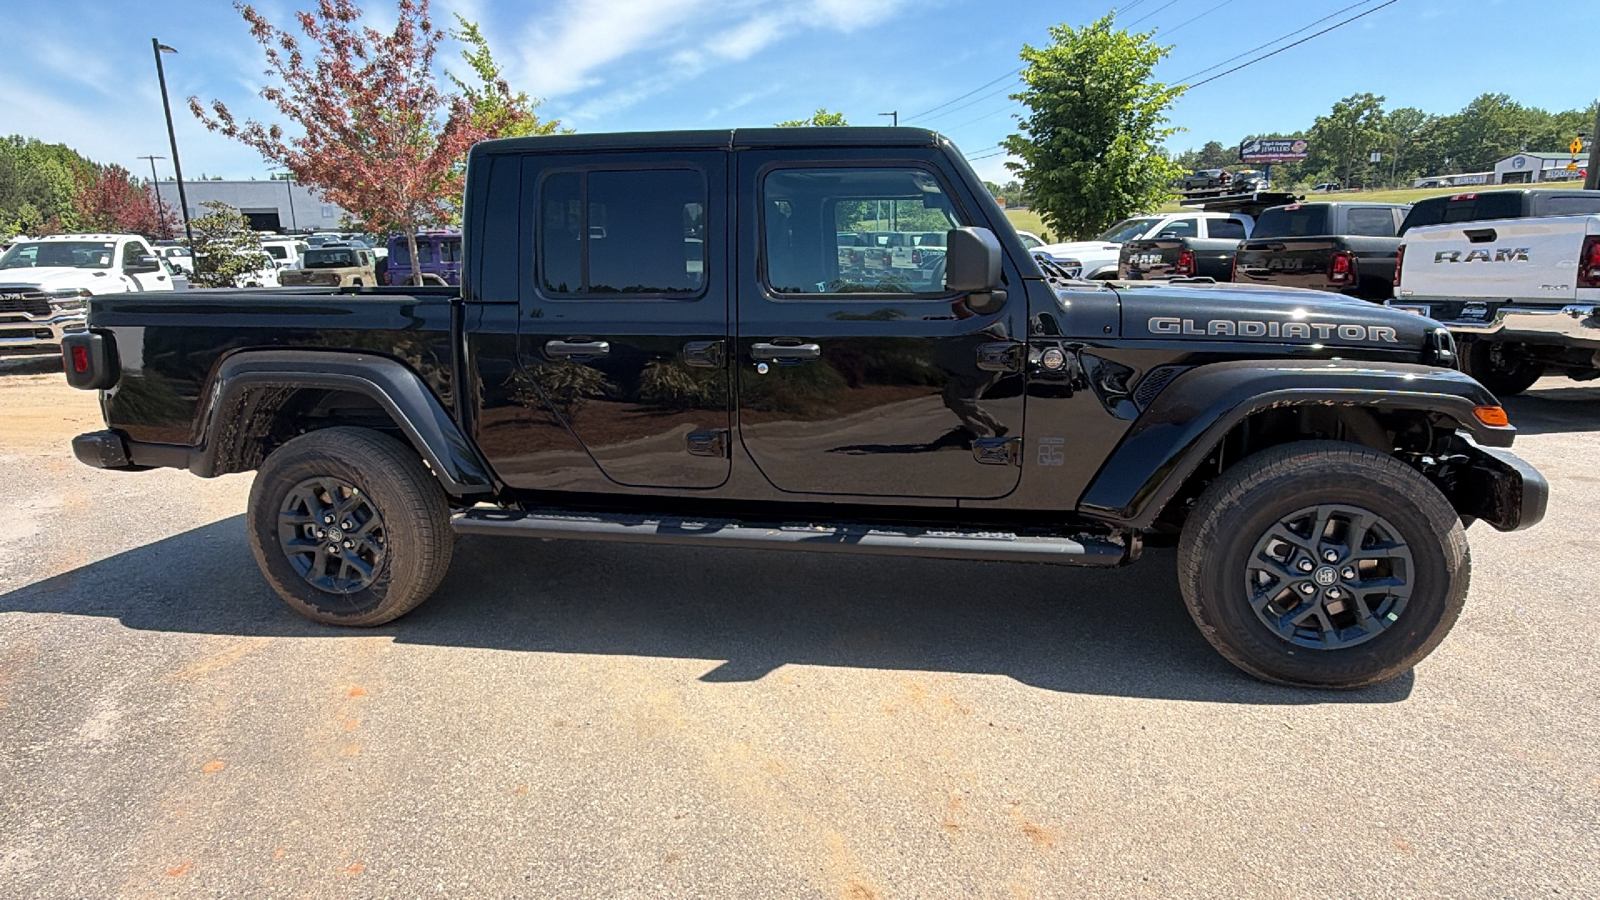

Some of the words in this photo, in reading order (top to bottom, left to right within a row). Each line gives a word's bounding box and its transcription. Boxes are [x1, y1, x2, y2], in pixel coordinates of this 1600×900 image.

[1128, 254, 1163, 263] RAM
[1434, 247, 1531, 263] RAM
[1252, 257, 1304, 269] RAM
[1148, 316, 1399, 343] GLADIATOR
